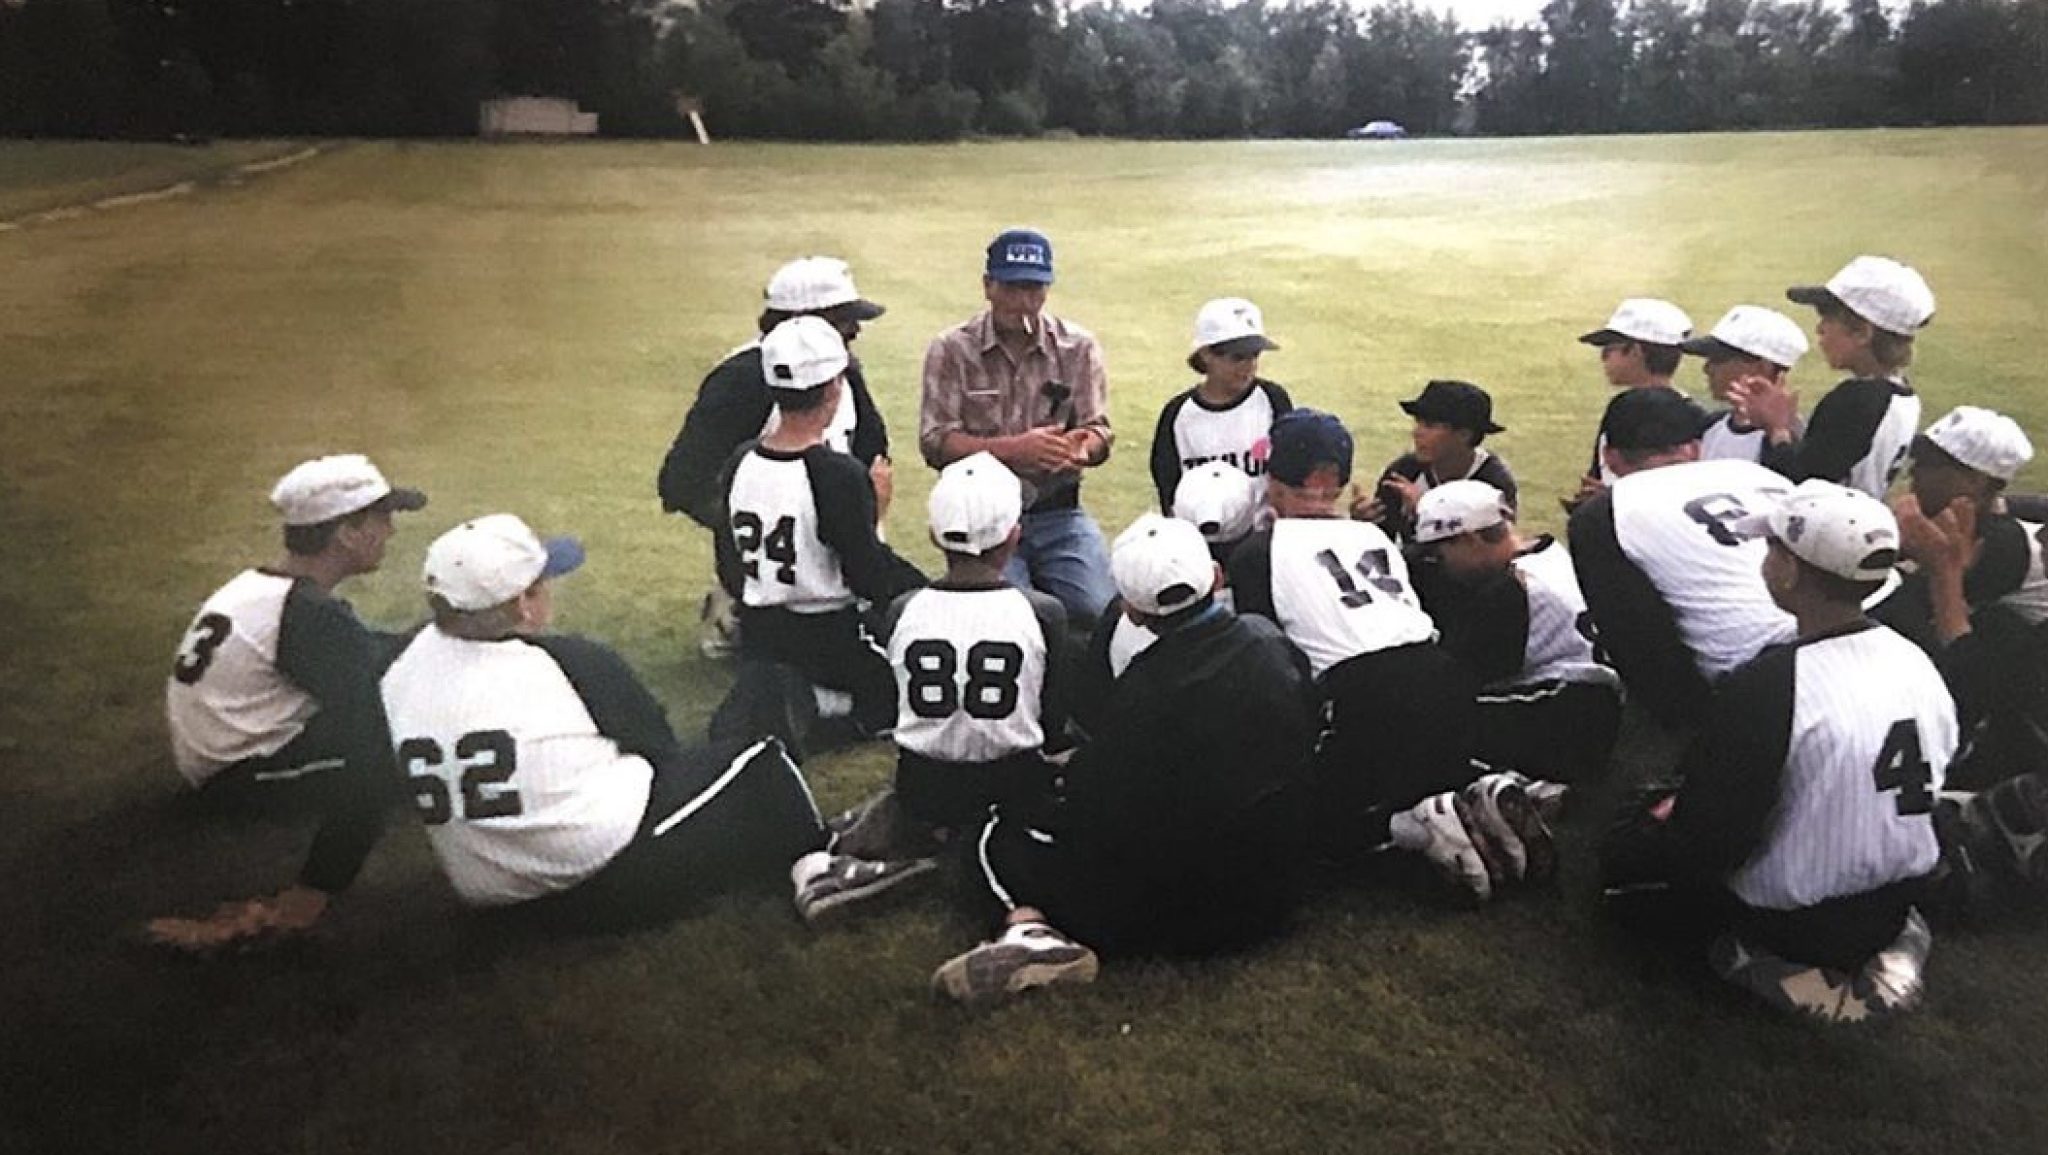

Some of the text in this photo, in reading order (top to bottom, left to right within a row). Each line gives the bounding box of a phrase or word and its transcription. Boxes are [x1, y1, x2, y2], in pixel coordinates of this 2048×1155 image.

[733, 509, 797, 585] 24
[175, 612, 232, 687] 3
[904, 637, 1024, 719] 88
[397, 729, 523, 824] 62
[1873, 717, 1933, 816] 4
